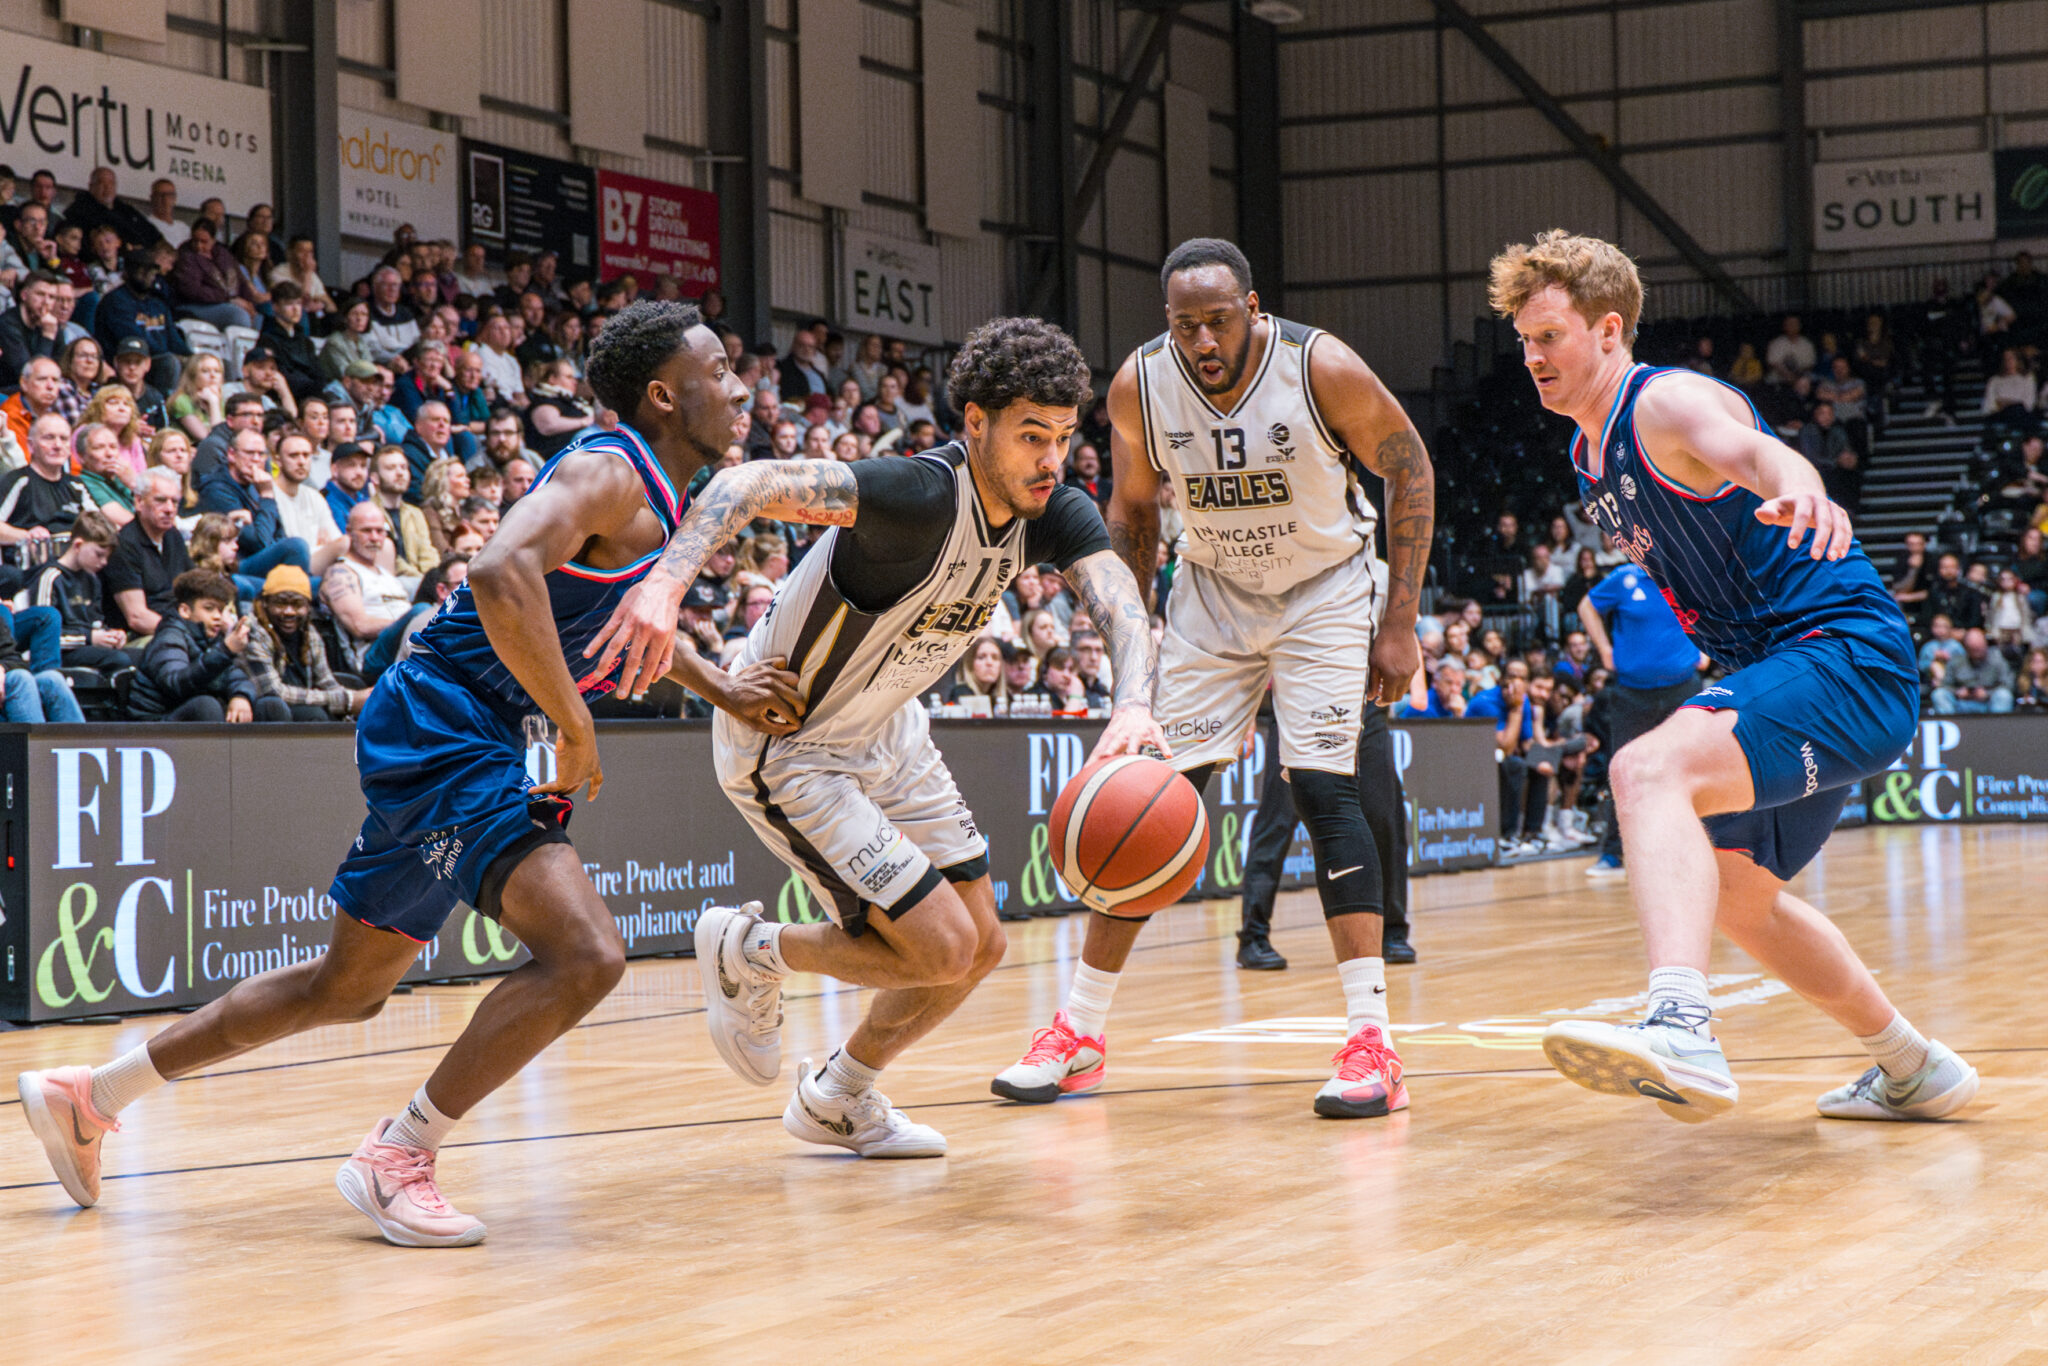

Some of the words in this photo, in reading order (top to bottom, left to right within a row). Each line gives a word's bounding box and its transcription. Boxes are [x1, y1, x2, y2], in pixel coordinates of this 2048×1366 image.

[0, 64, 155, 172] Vertu
[166, 112, 259, 154] Motors
[168, 157, 227, 185] ARENA
[356, 187, 400, 210] HOTEL
[1823, 192, 1983, 231] SOUTH
[854, 269, 933, 328] EAST
[1211, 427, 1247, 470] 13
[1185, 472, 1290, 509] EAGLES
[1222, 542, 1275, 558] LLEGE
[965, 557, 993, 599] 1
[51, 747, 177, 869] FP
[626, 859, 695, 895] Protect
[698, 850, 735, 888] and
[204, 888, 257, 929] Fire
[263, 886, 337, 925] Prote
[614, 901, 698, 949] pliance
[202, 933, 329, 981] Complia
